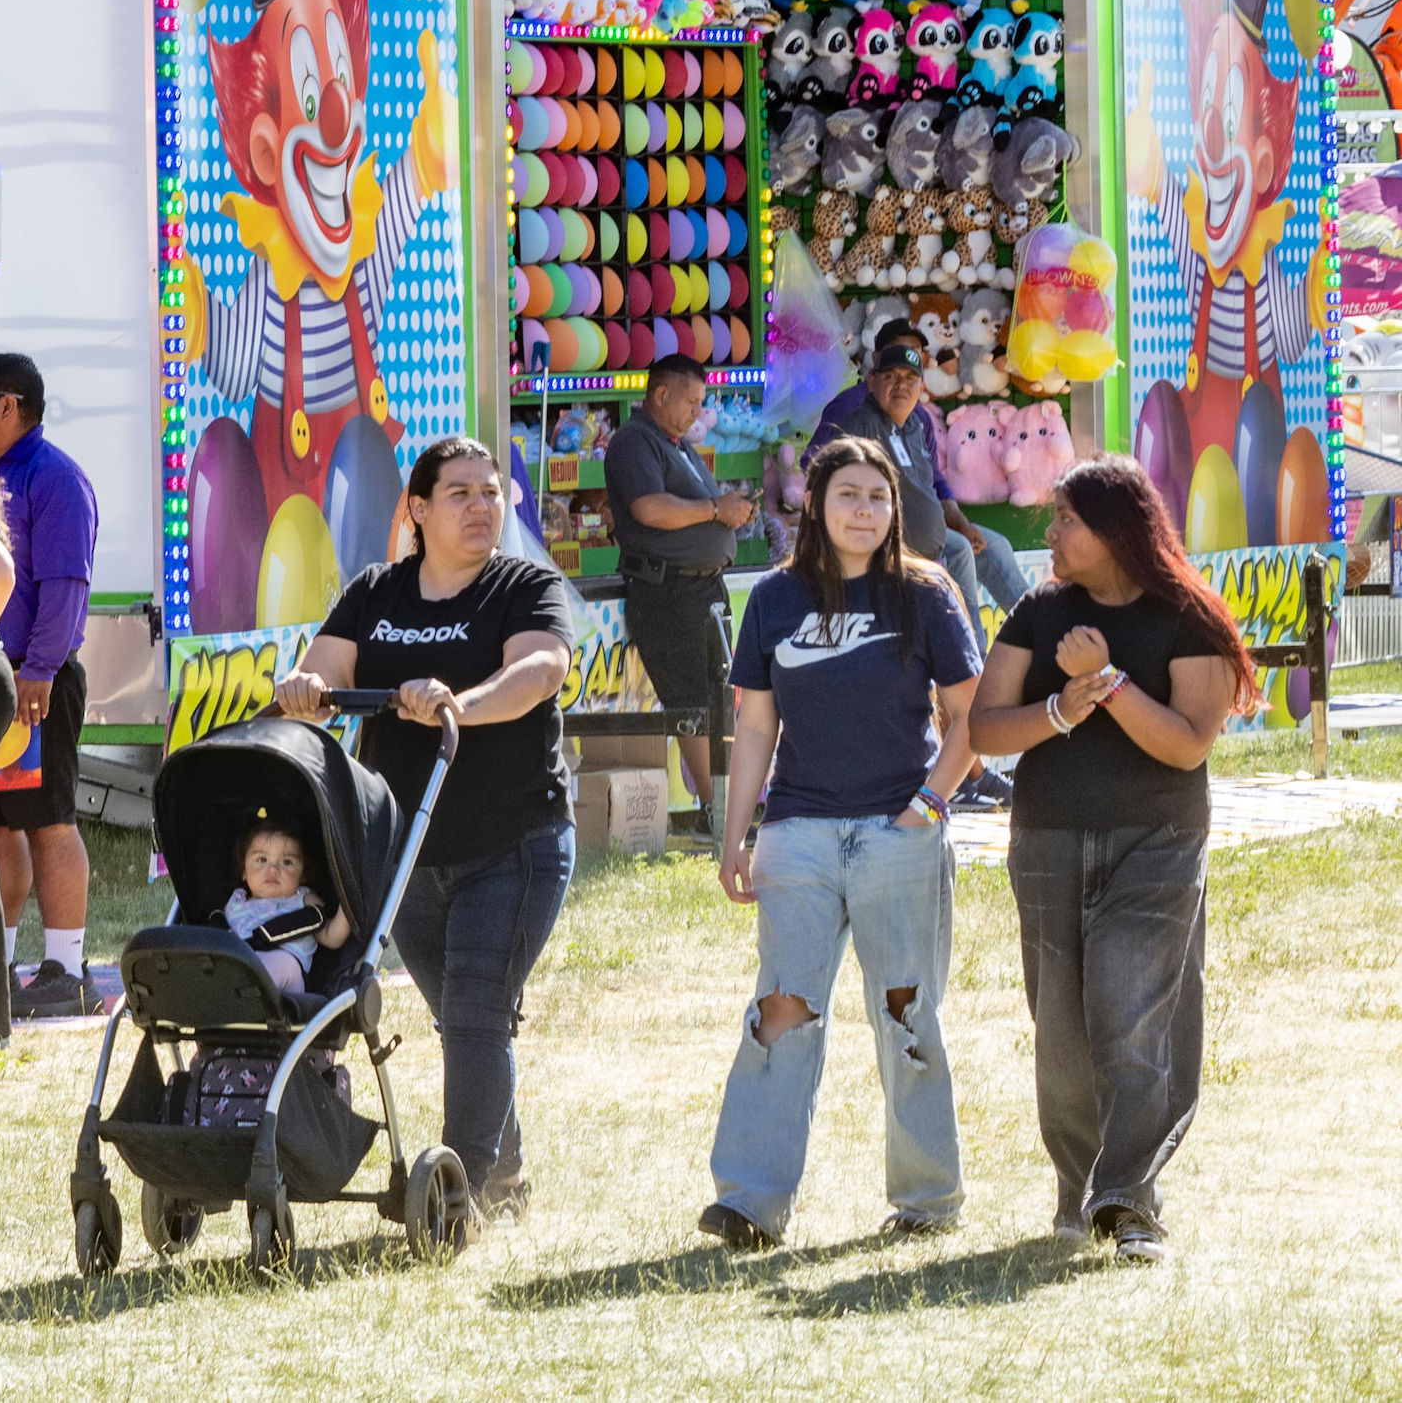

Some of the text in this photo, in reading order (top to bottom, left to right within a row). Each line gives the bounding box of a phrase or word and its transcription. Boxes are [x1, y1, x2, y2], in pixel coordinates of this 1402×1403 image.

[1337, 146, 1378, 164] PASS
[549, 458, 579, 485] MEDIUM
[552, 551, 580, 572] MEDIUM
[793, 611, 875, 647] NIKE
[167, 642, 279, 756] KIDS
